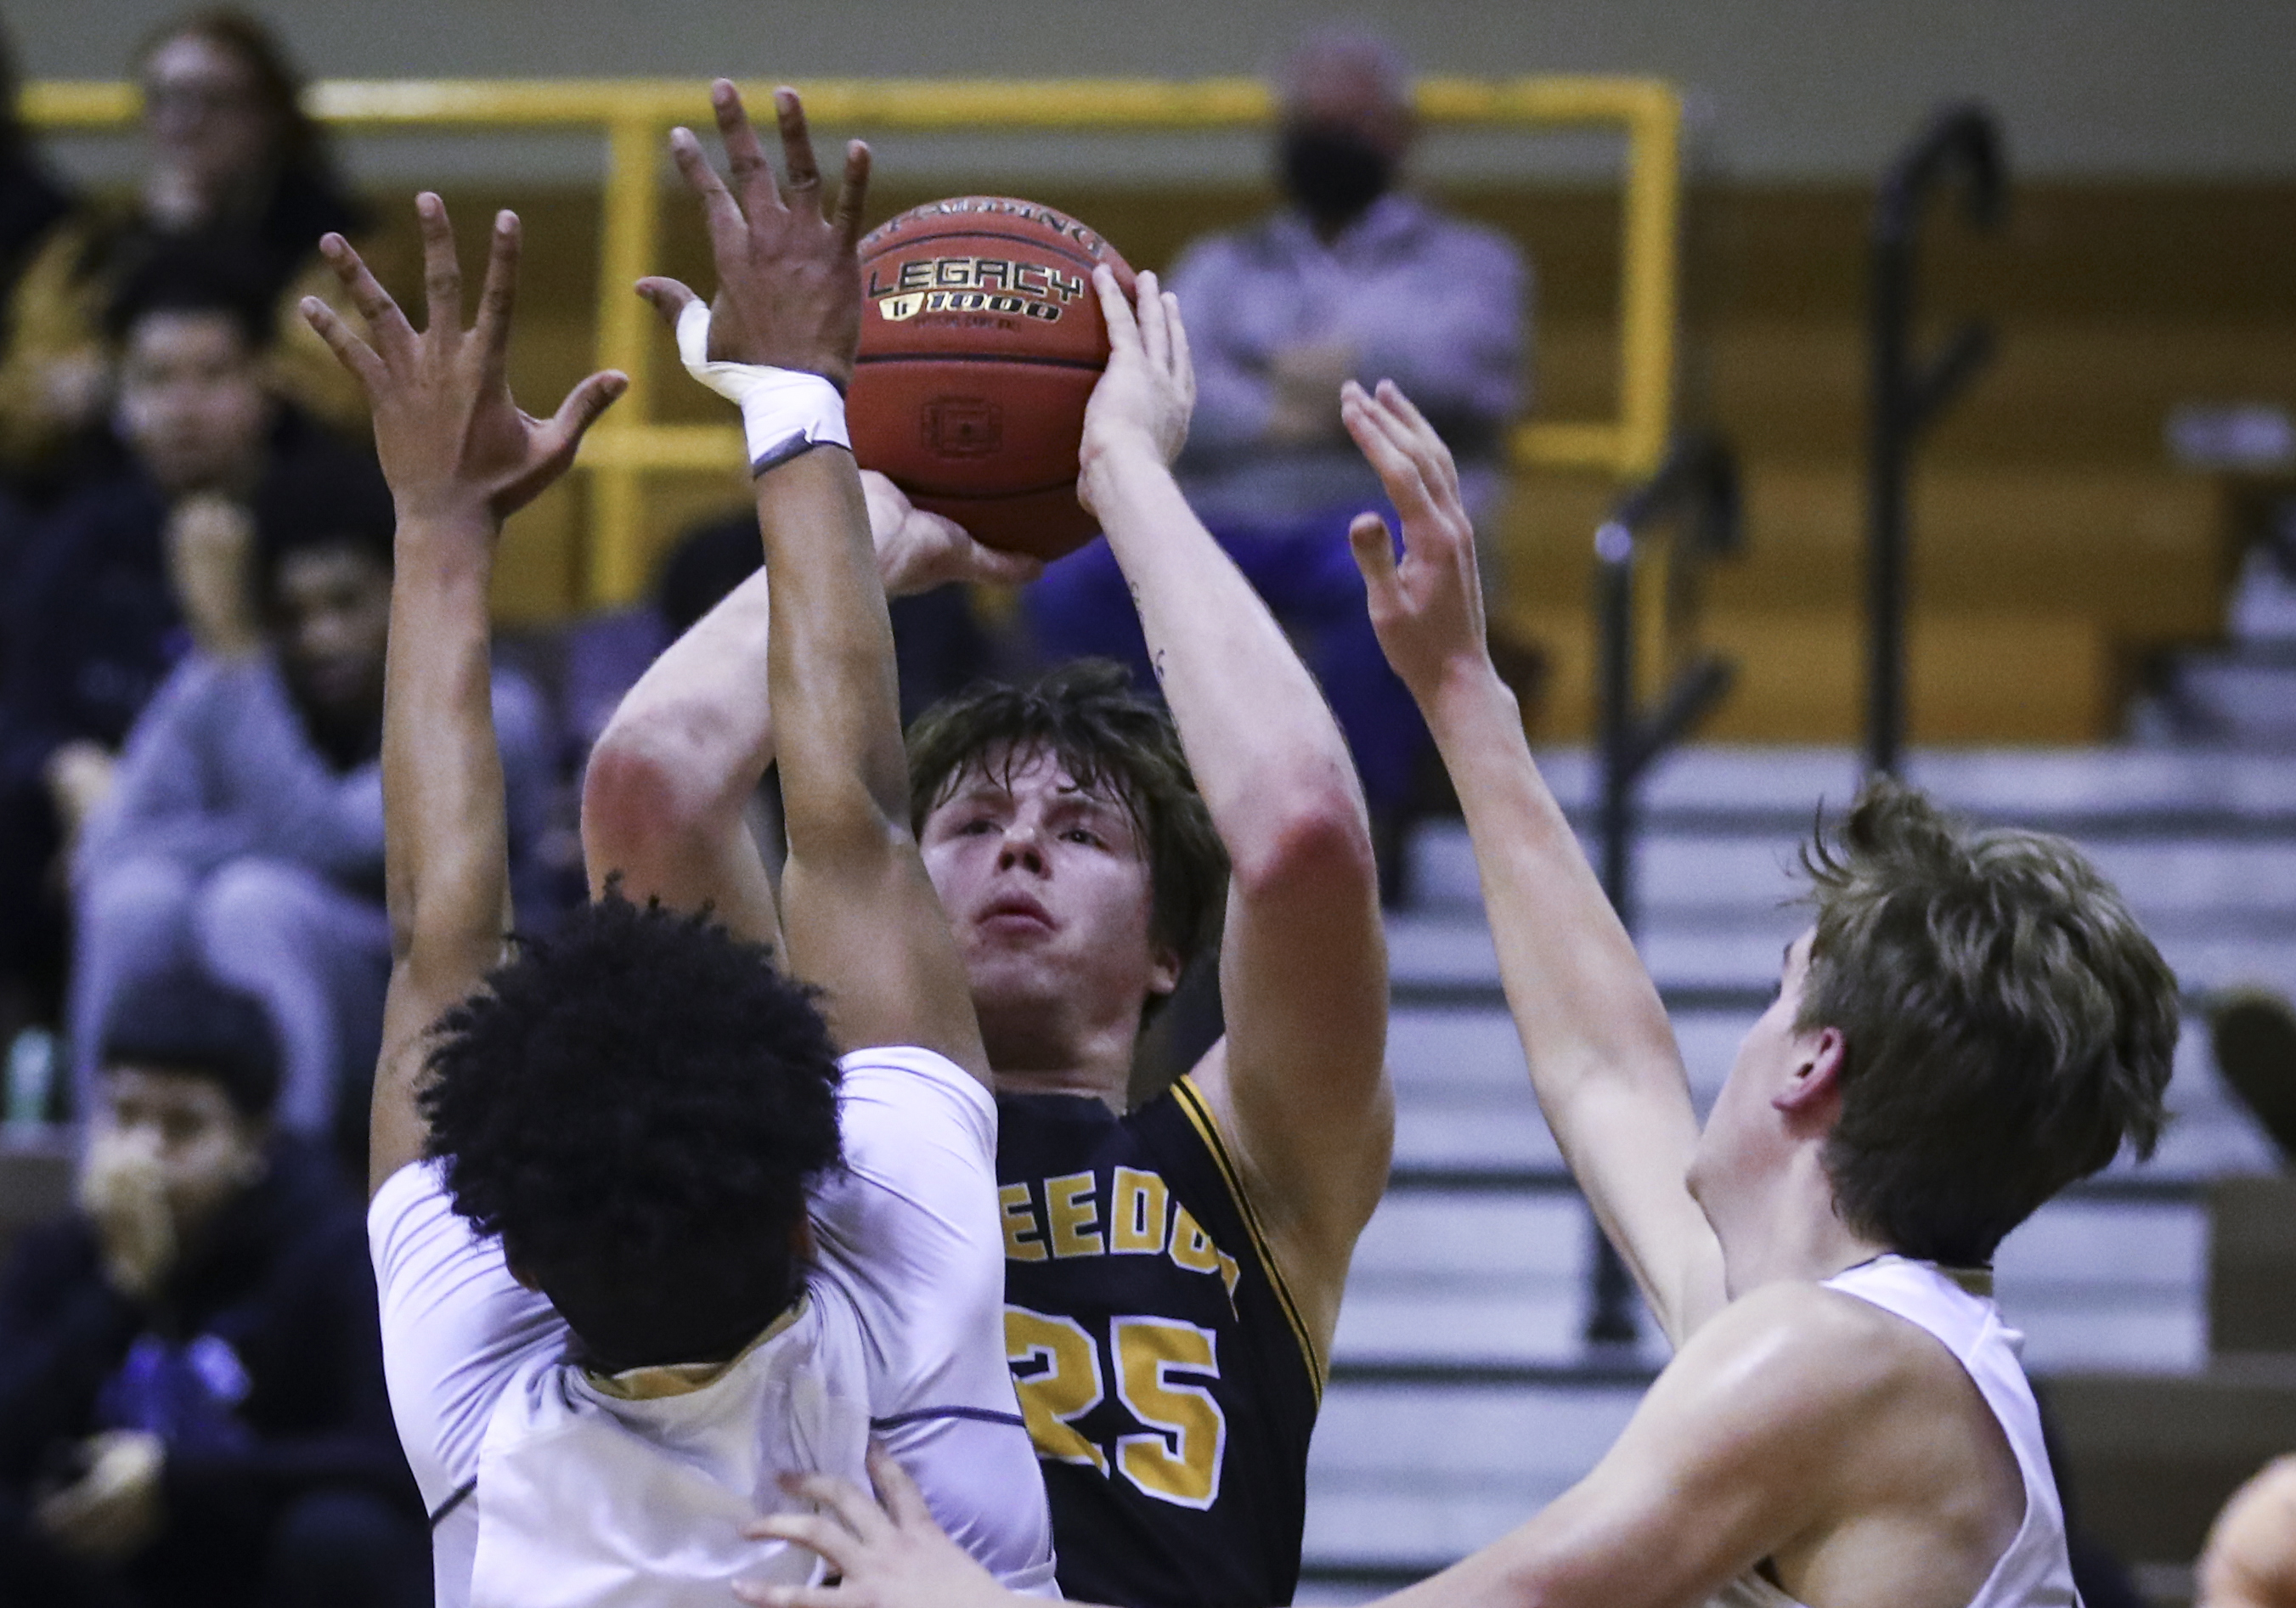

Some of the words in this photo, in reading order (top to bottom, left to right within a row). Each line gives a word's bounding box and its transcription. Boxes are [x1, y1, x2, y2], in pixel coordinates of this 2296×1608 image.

[867, 257, 1085, 305] LEGACY
[927, 291, 1062, 323] 1000
[998, 1165, 1240, 1322] EEDO
[1004, 1303, 1227, 1511] 25
